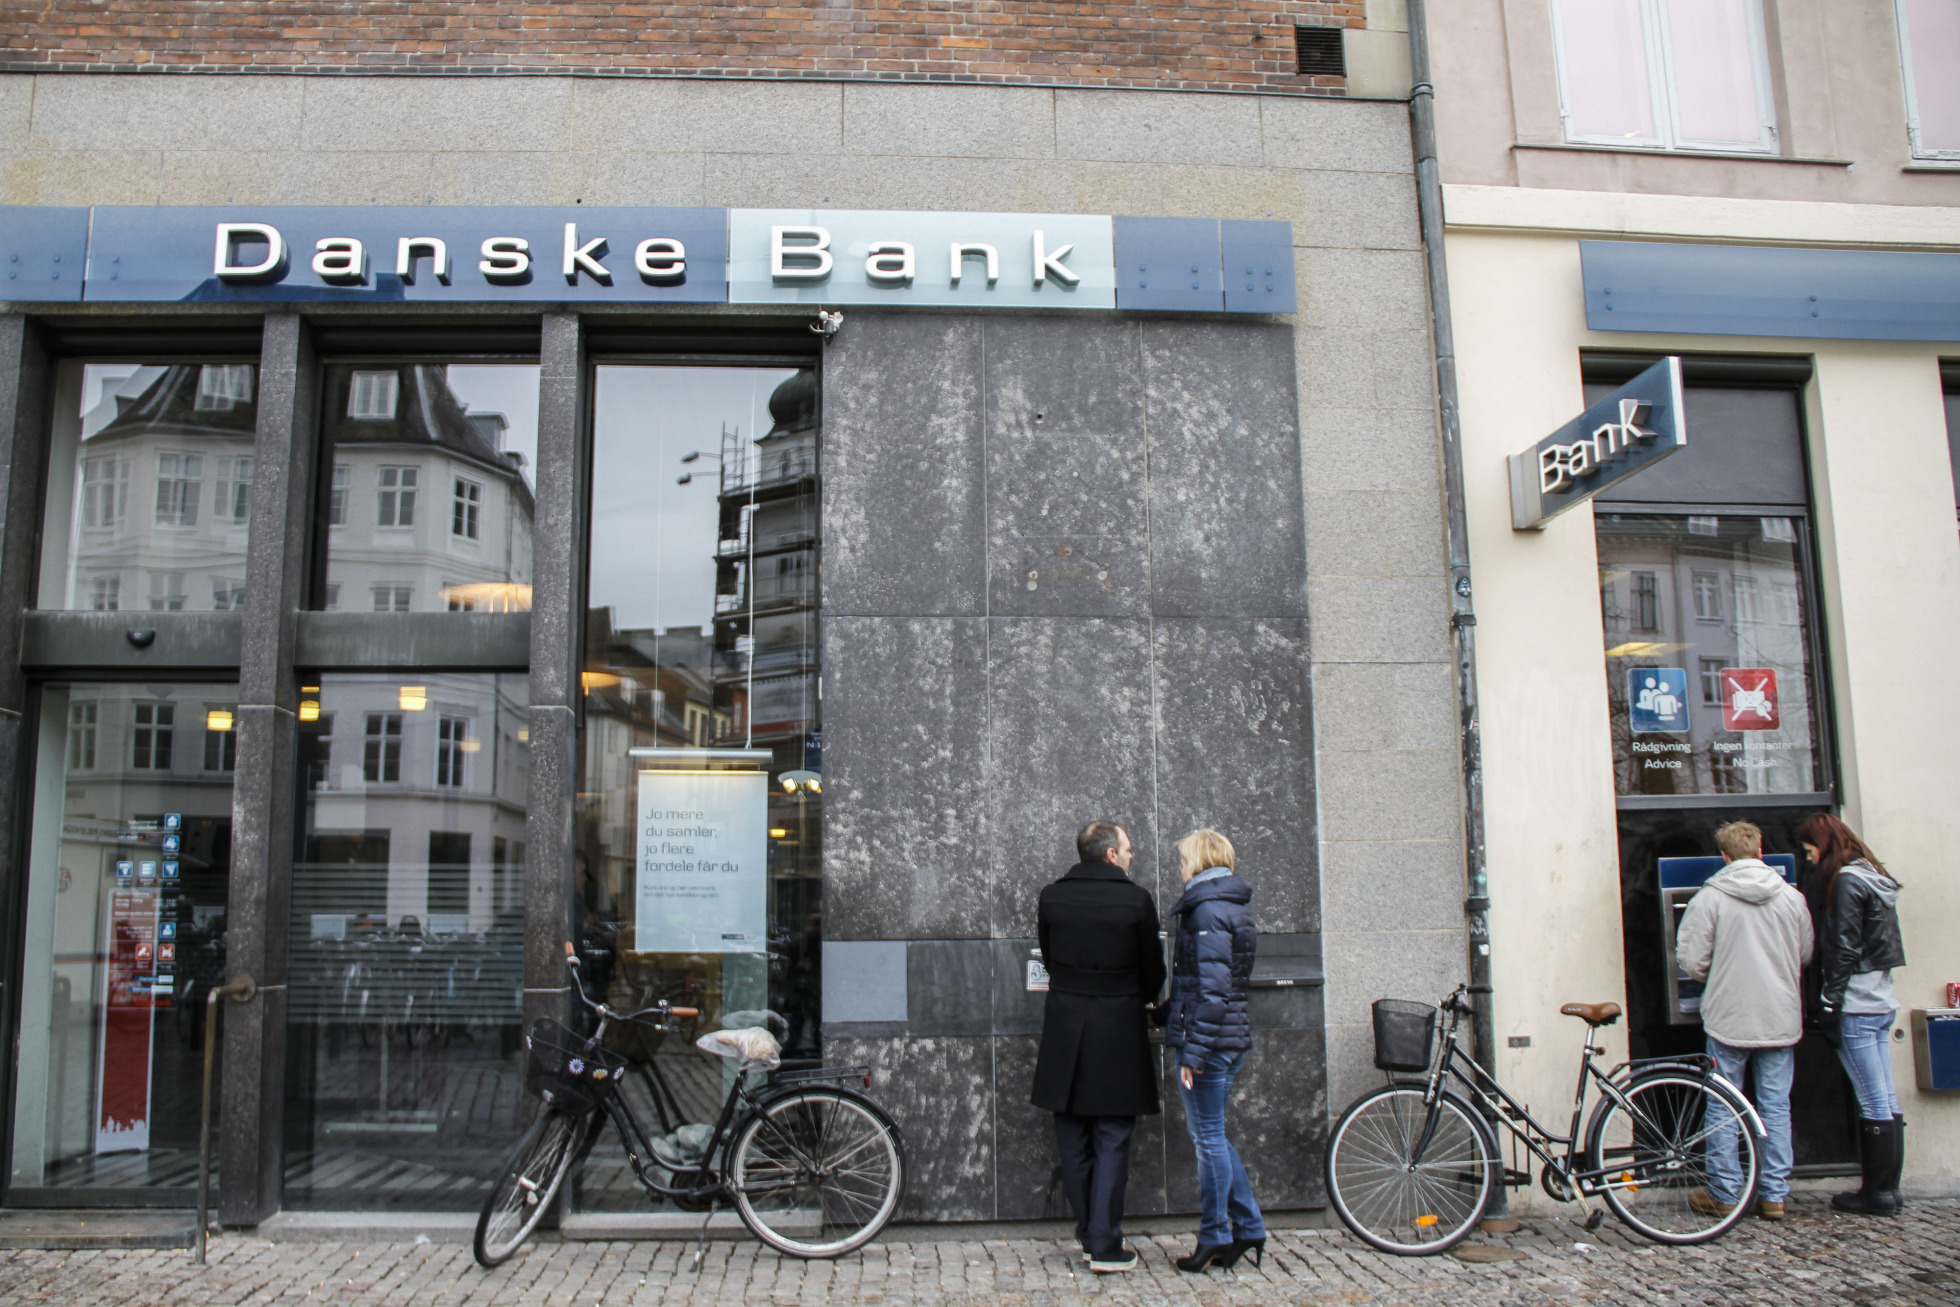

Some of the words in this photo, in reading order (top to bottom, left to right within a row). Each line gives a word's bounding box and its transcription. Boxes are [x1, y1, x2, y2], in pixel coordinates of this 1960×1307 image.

[212, 221, 687, 284] Danske
[770, 225, 1081, 287] Bank
[1538, 398, 1658, 494] Bank
[1632, 741, 1692, 753] Rådgivning
[1713, 740, 1743, 753] Ingen
[1644, 758, 1682, 769] Advice
[1732, 757, 1748, 768] No
[1750, 757, 1778, 768] Cash
[645, 807, 663, 820] Jo
[666, 810, 704, 820] mere
[646, 825, 663, 837] du
[666, 825, 718, 839] samler,
[644, 842, 658, 857] jo
[661, 841, 695, 854] flere
[644, 859, 695, 872] fordele
[698, 859, 718, 872] får
[721, 860, 739, 872] du
